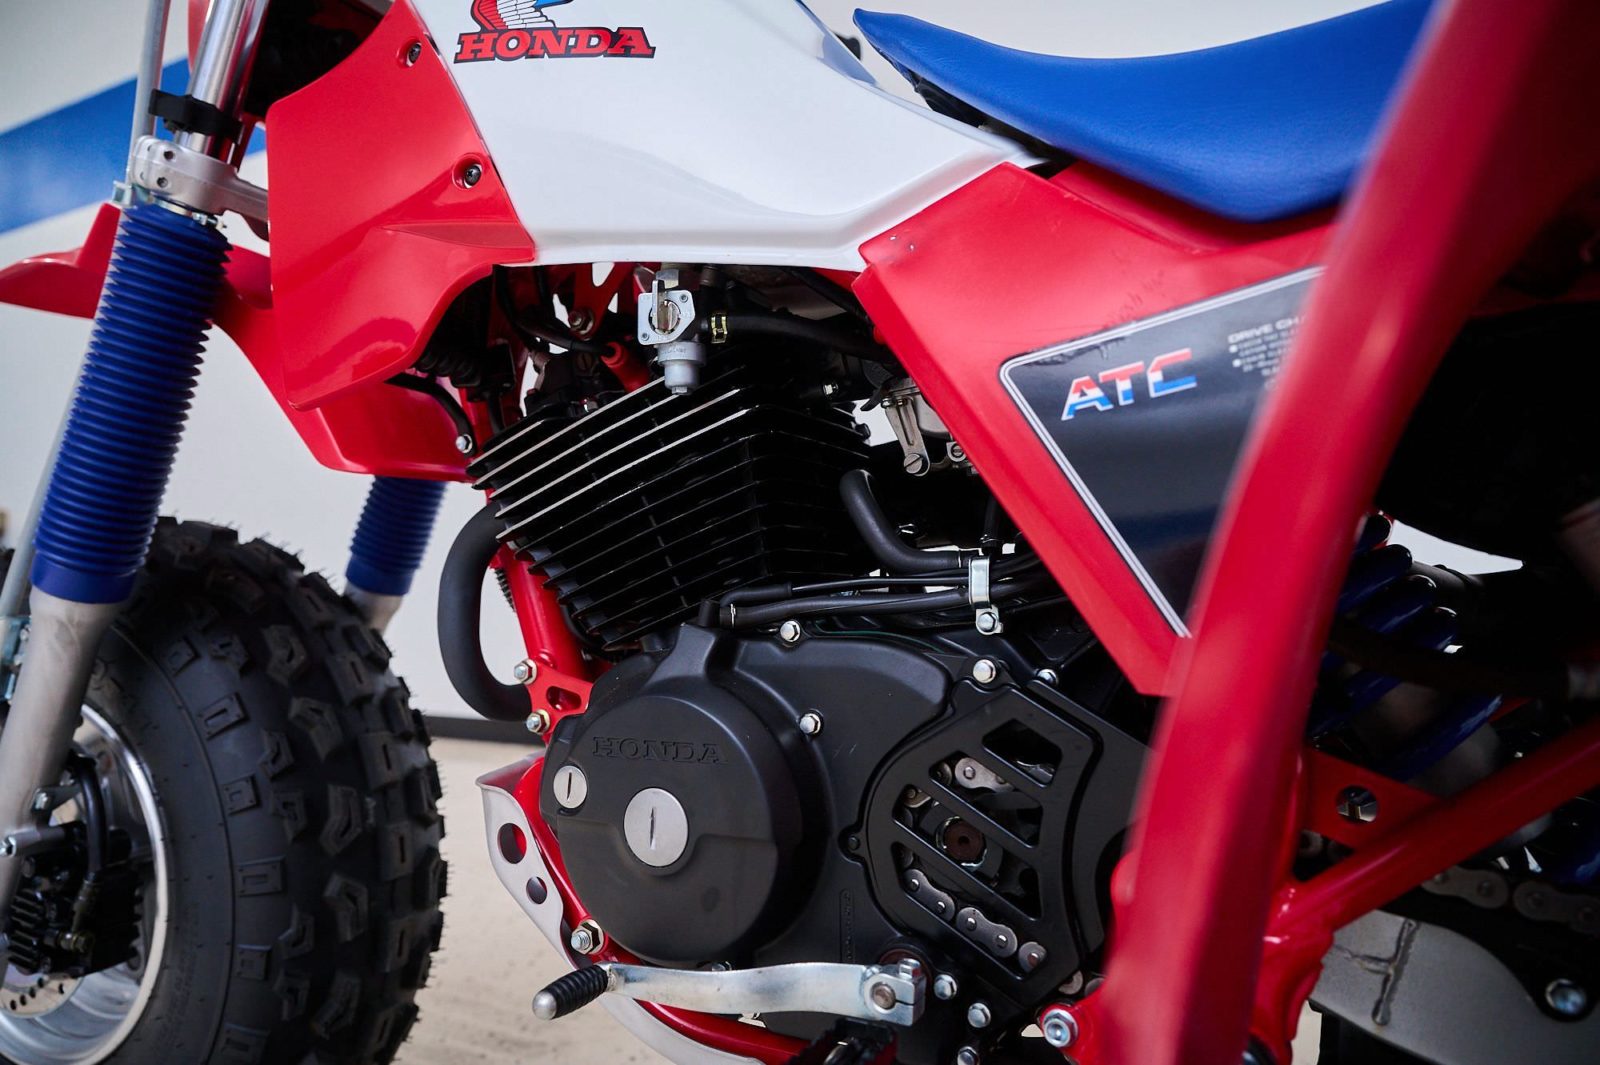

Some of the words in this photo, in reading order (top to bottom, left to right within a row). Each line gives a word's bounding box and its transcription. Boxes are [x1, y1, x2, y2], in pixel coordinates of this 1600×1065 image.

[454, 27, 656, 63] HONDA
[1228, 323, 1273, 344] DRIVE
[1061, 348, 1198, 421] ATC
[592, 736, 725, 763] HONDA
